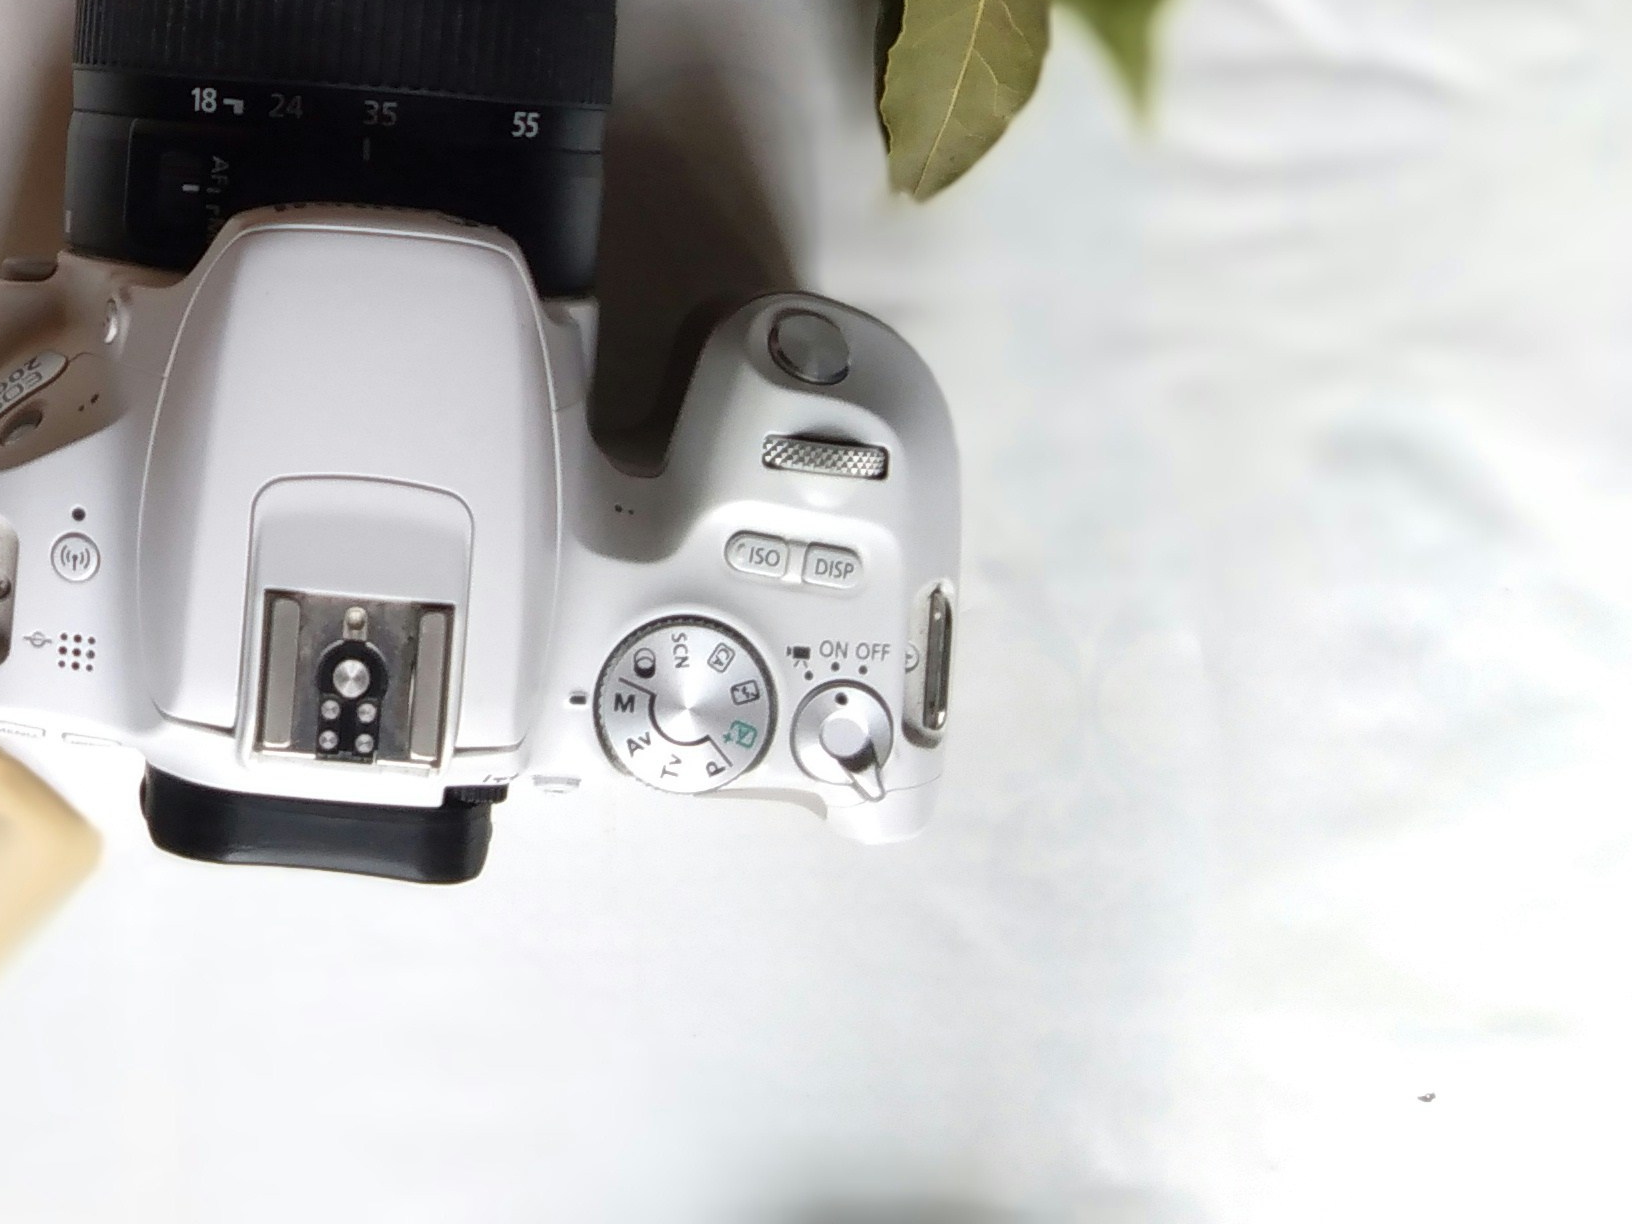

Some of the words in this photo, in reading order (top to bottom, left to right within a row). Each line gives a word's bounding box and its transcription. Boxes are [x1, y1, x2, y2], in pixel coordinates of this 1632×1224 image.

[191, 87, 217, 114] 18
[269, 93, 304, 119] 24
[363, 100, 397, 126] 35
[511, 112, 540, 138] 55
[749, 545, 780, 567] ISO
[814, 557, 854, 580] DISP
[671, 632, 690, 669] SCN
[819, 639, 849, 660] ON
[855, 641, 892, 661] OFF
[614, 693, 635, 714] M
[625, 731, 653, 758] Av
[660, 754, 683, 780] Tv
[705, 760, 727, 778] P
